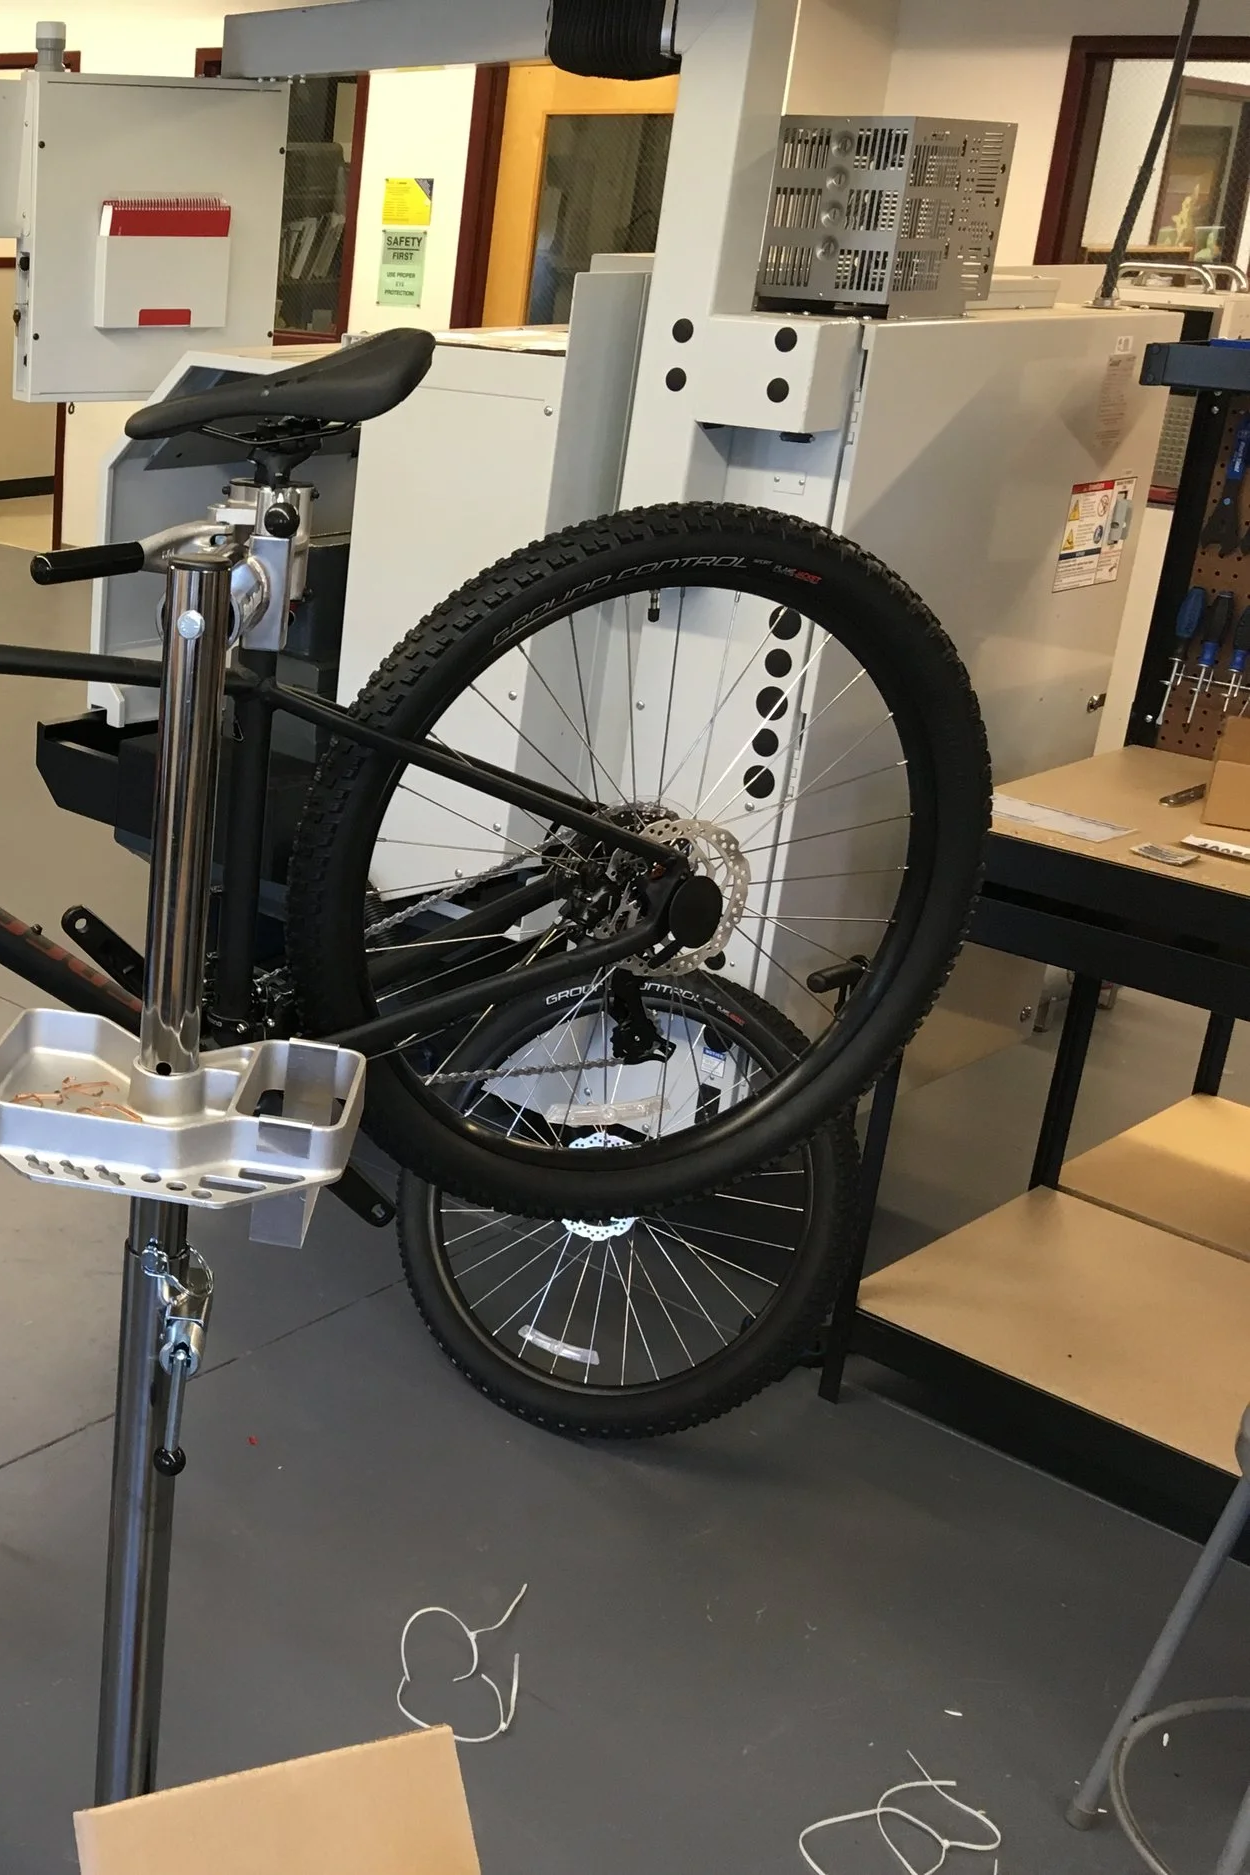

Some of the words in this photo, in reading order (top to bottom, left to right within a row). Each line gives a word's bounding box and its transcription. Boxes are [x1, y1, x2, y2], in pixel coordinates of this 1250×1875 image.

[386, 236, 422, 247] SAFETY
[392, 252, 414, 261] FIRST
[616, 556, 748, 582] CONTROL
